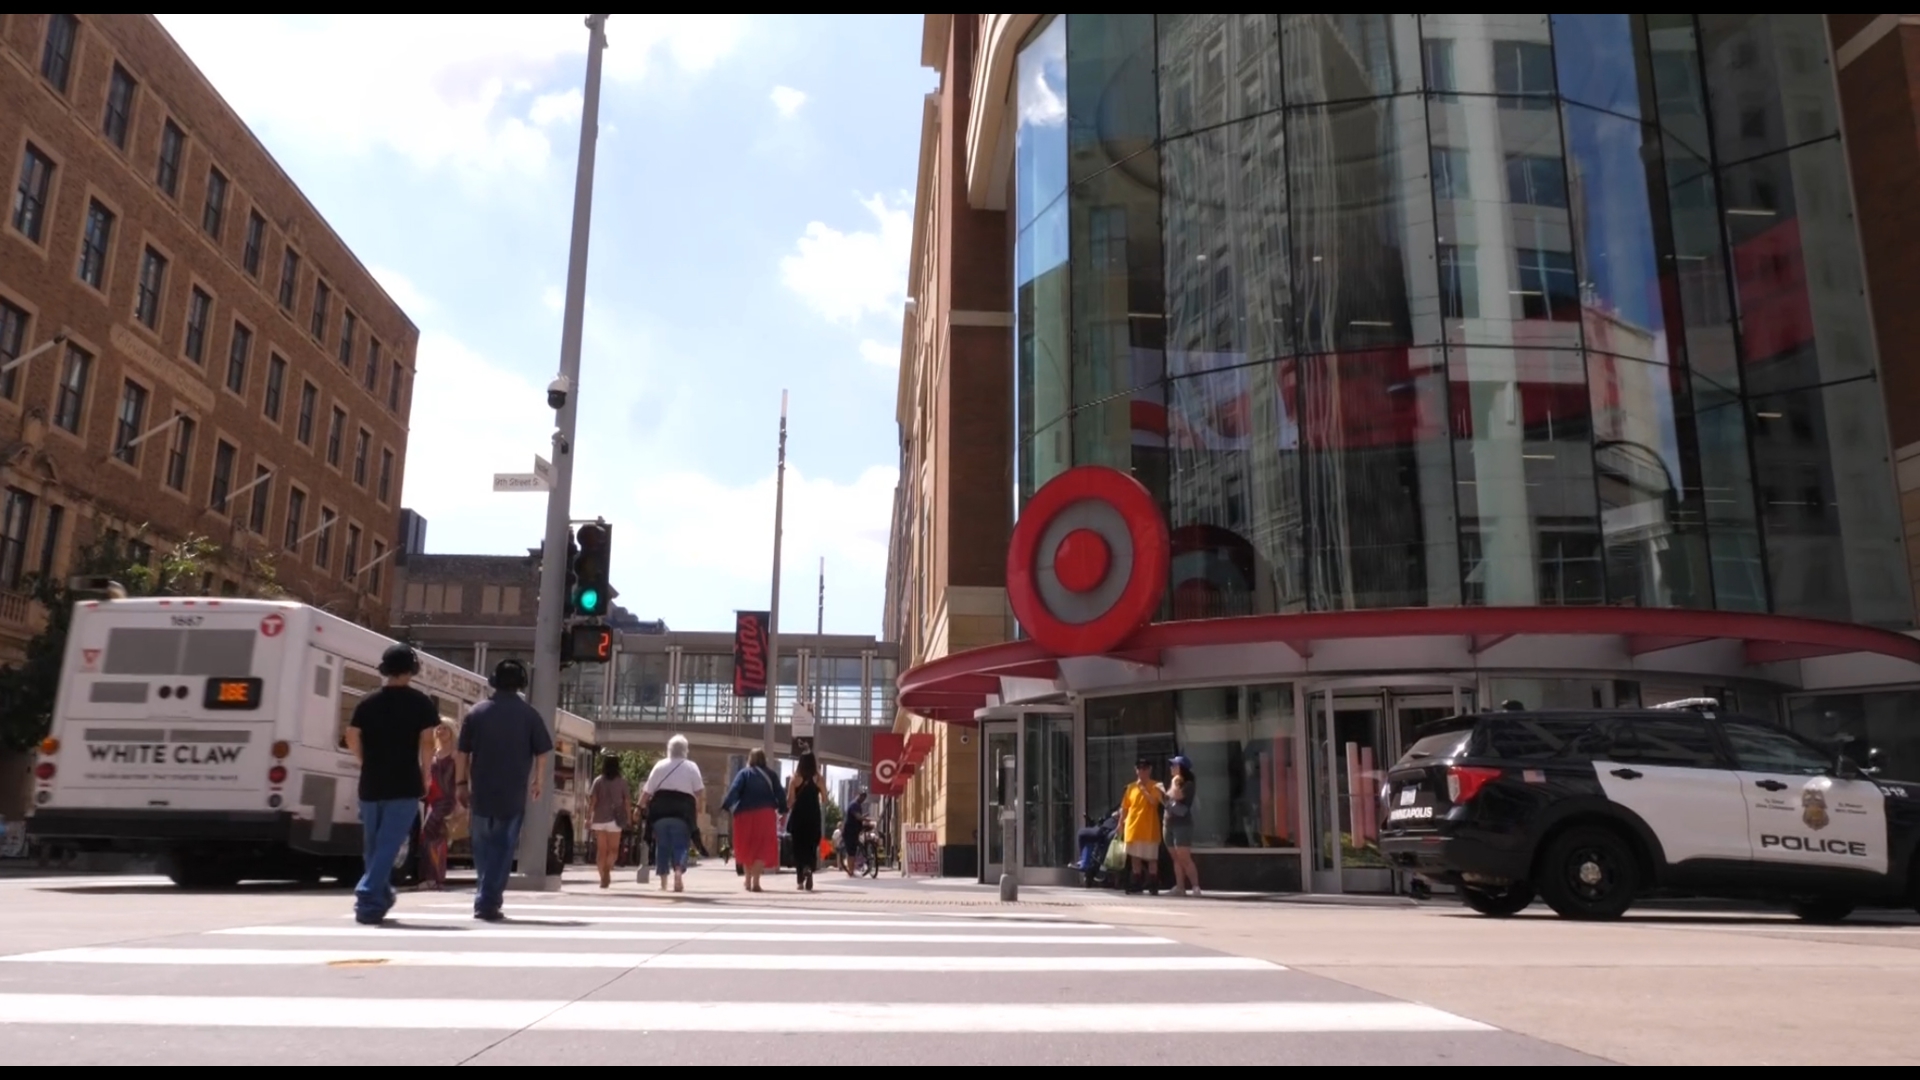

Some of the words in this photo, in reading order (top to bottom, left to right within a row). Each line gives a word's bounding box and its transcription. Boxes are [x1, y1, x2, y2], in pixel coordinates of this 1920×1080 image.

[495, 477, 508, 486] 9th
[509, 477, 532, 486] Street
[598, 632, 609, 656] 2
[733, 614, 767, 697] Twins
[86, 744, 168, 764] WHITE
[173, 745, 246, 765] CLAW
[907, 842, 937, 863] NAILS
[1760, 834, 1867, 857] POLICE
